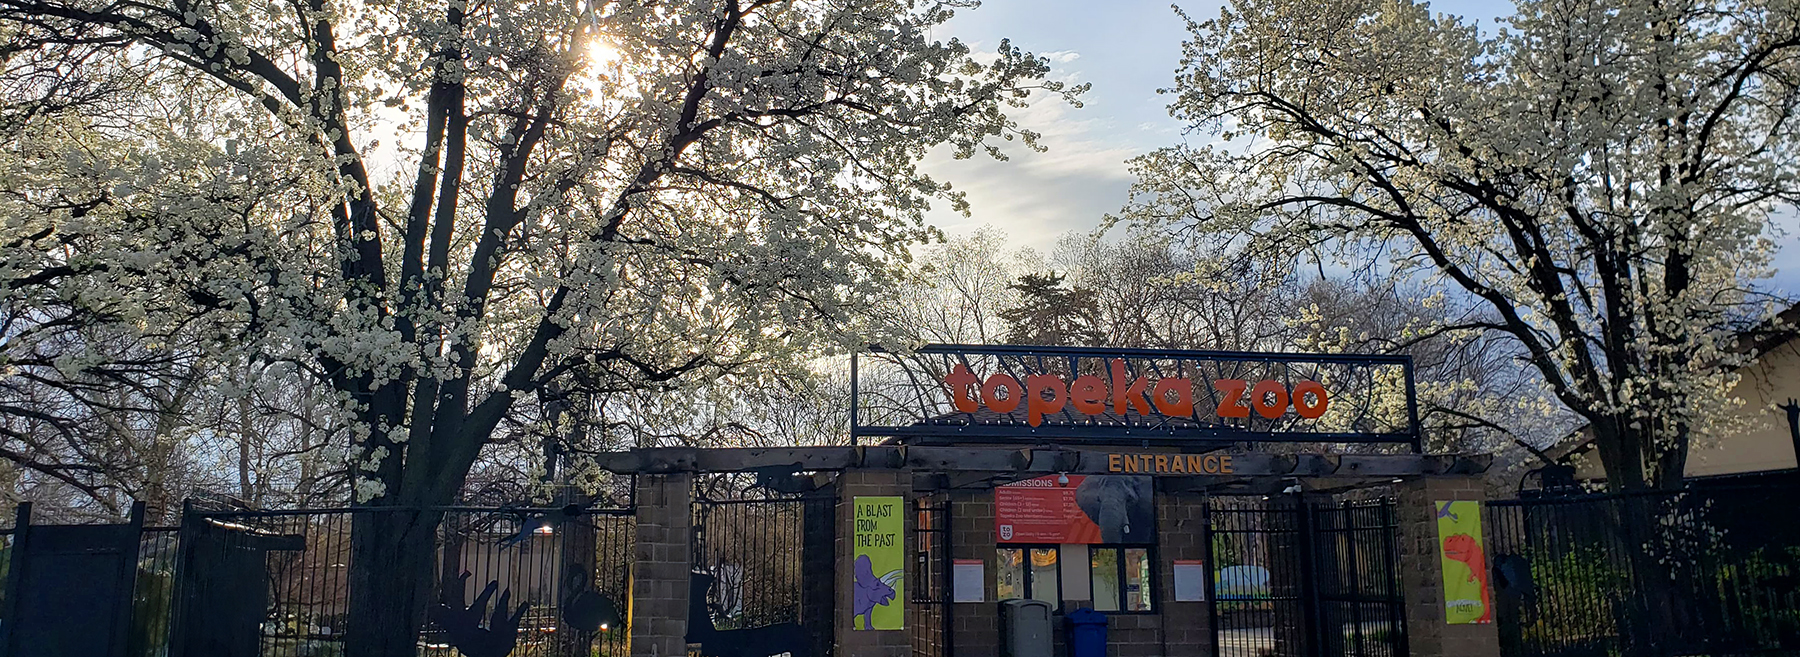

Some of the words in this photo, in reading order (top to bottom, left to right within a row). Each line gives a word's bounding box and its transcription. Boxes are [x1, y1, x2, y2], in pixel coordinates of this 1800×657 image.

[945, 358, 1192, 427] topeka
[1213, 379, 1329, 419] zoo
[1108, 454, 1233, 475] ENTRANCE
[1003, 479, 1053, 487] MISSIONS
[857, 504, 863, 518] A
[866, 504, 893, 518] BLAST
[857, 519, 878, 532] FROM
[856, 534, 872, 547] THE
[874, 534, 895, 547] PAST
